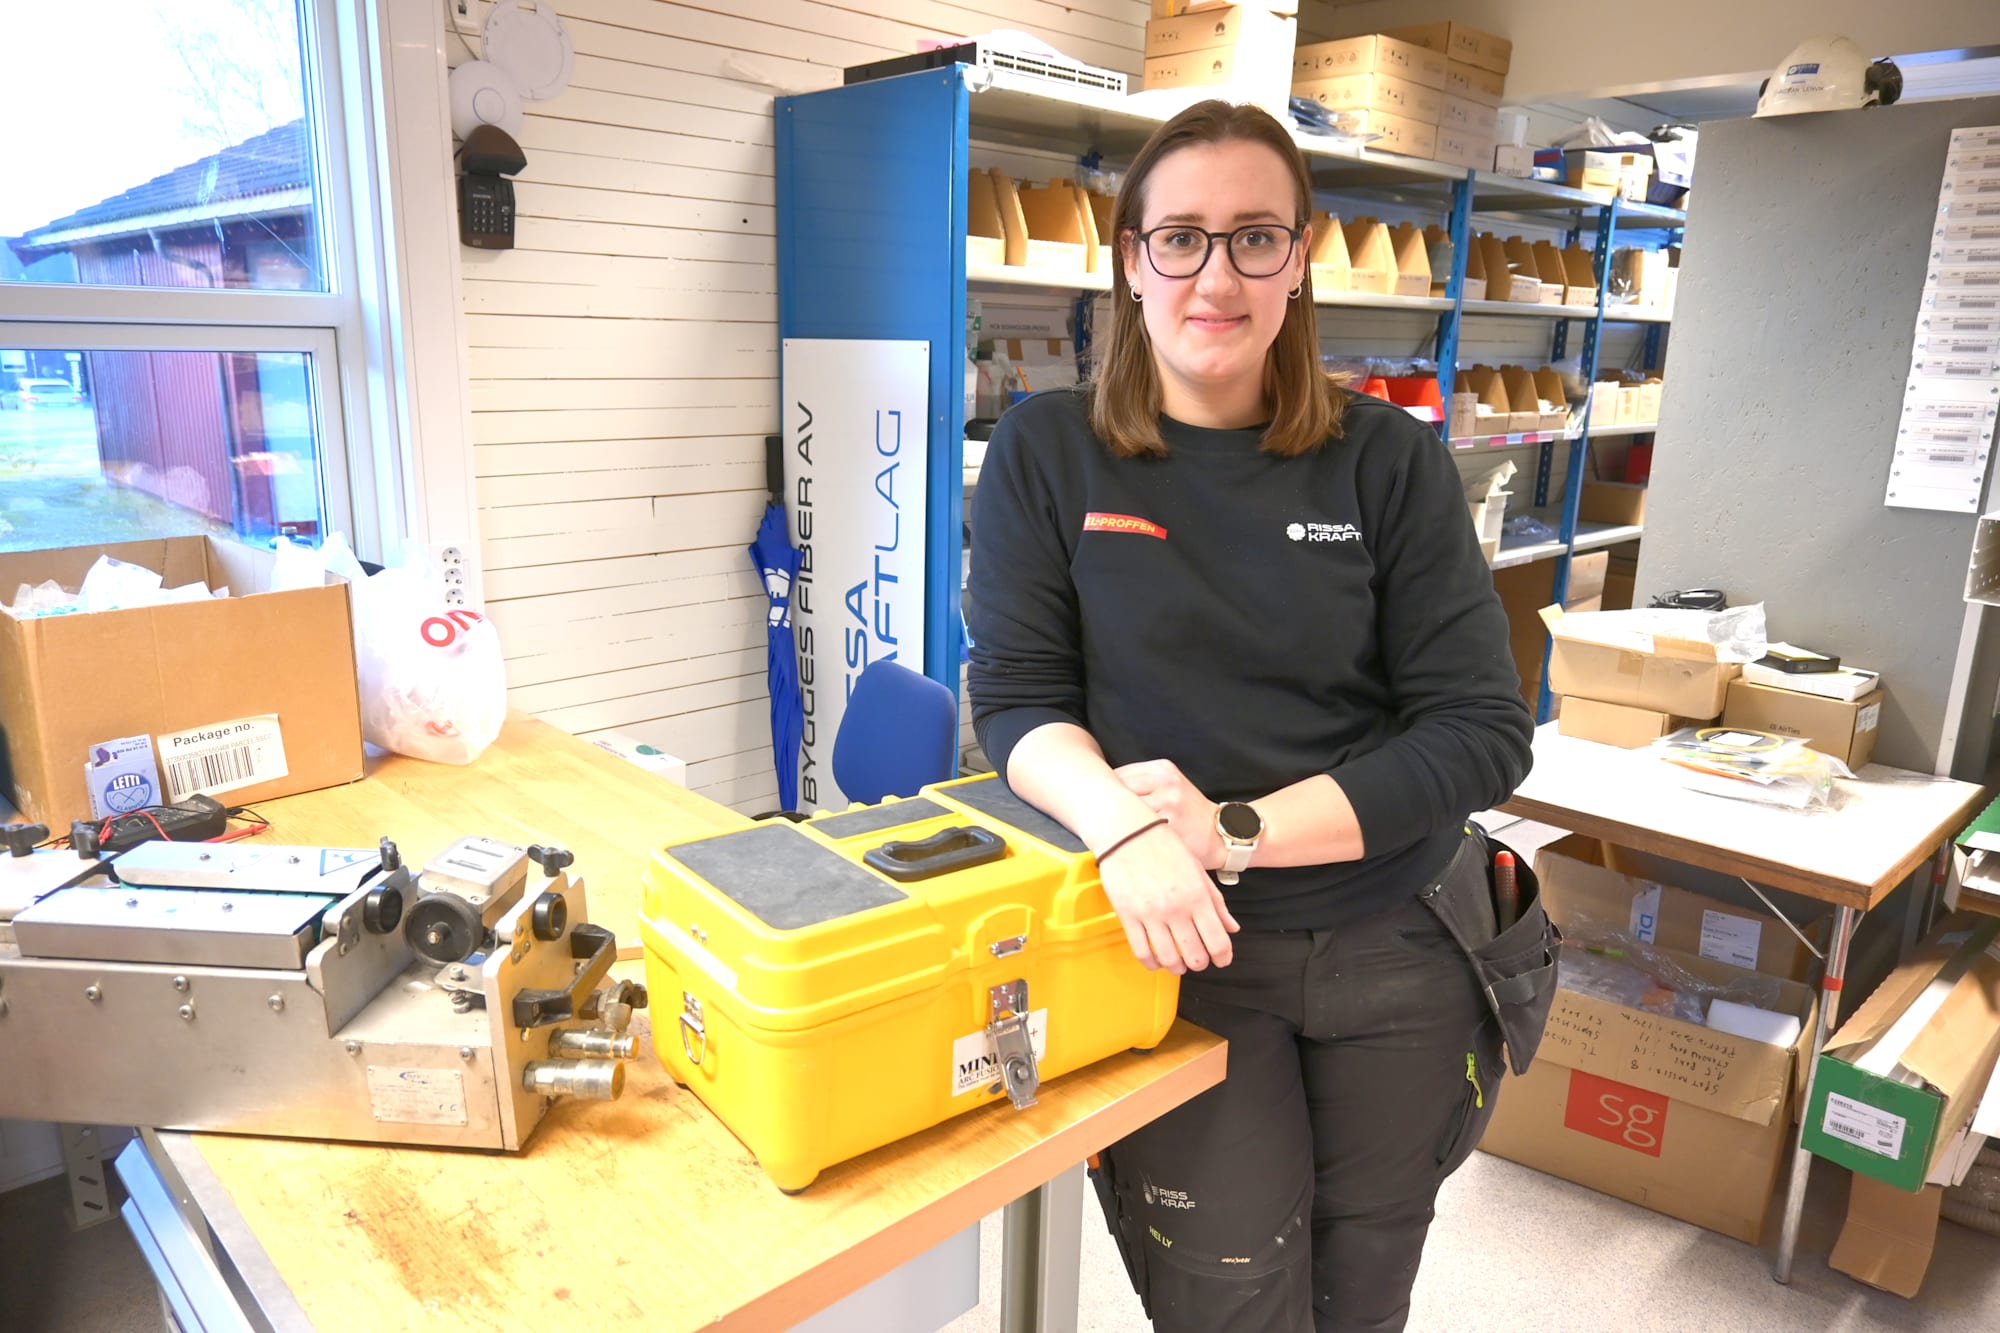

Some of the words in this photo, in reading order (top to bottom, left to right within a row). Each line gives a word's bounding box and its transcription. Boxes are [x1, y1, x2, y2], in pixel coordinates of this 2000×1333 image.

[797, 400, 813, 466] AV
[798, 476, 813, 614] FIBER
[874, 410, 901, 662] FTLAG
[1307, 523, 1356, 532] RISSA
[1308, 532, 1363, 542] KRAFT
[173, 727, 230, 747] Package
[235, 723, 255, 733] no.
[799, 626, 817, 804] BYGGES
[113, 774, 140, 791] LETTI
